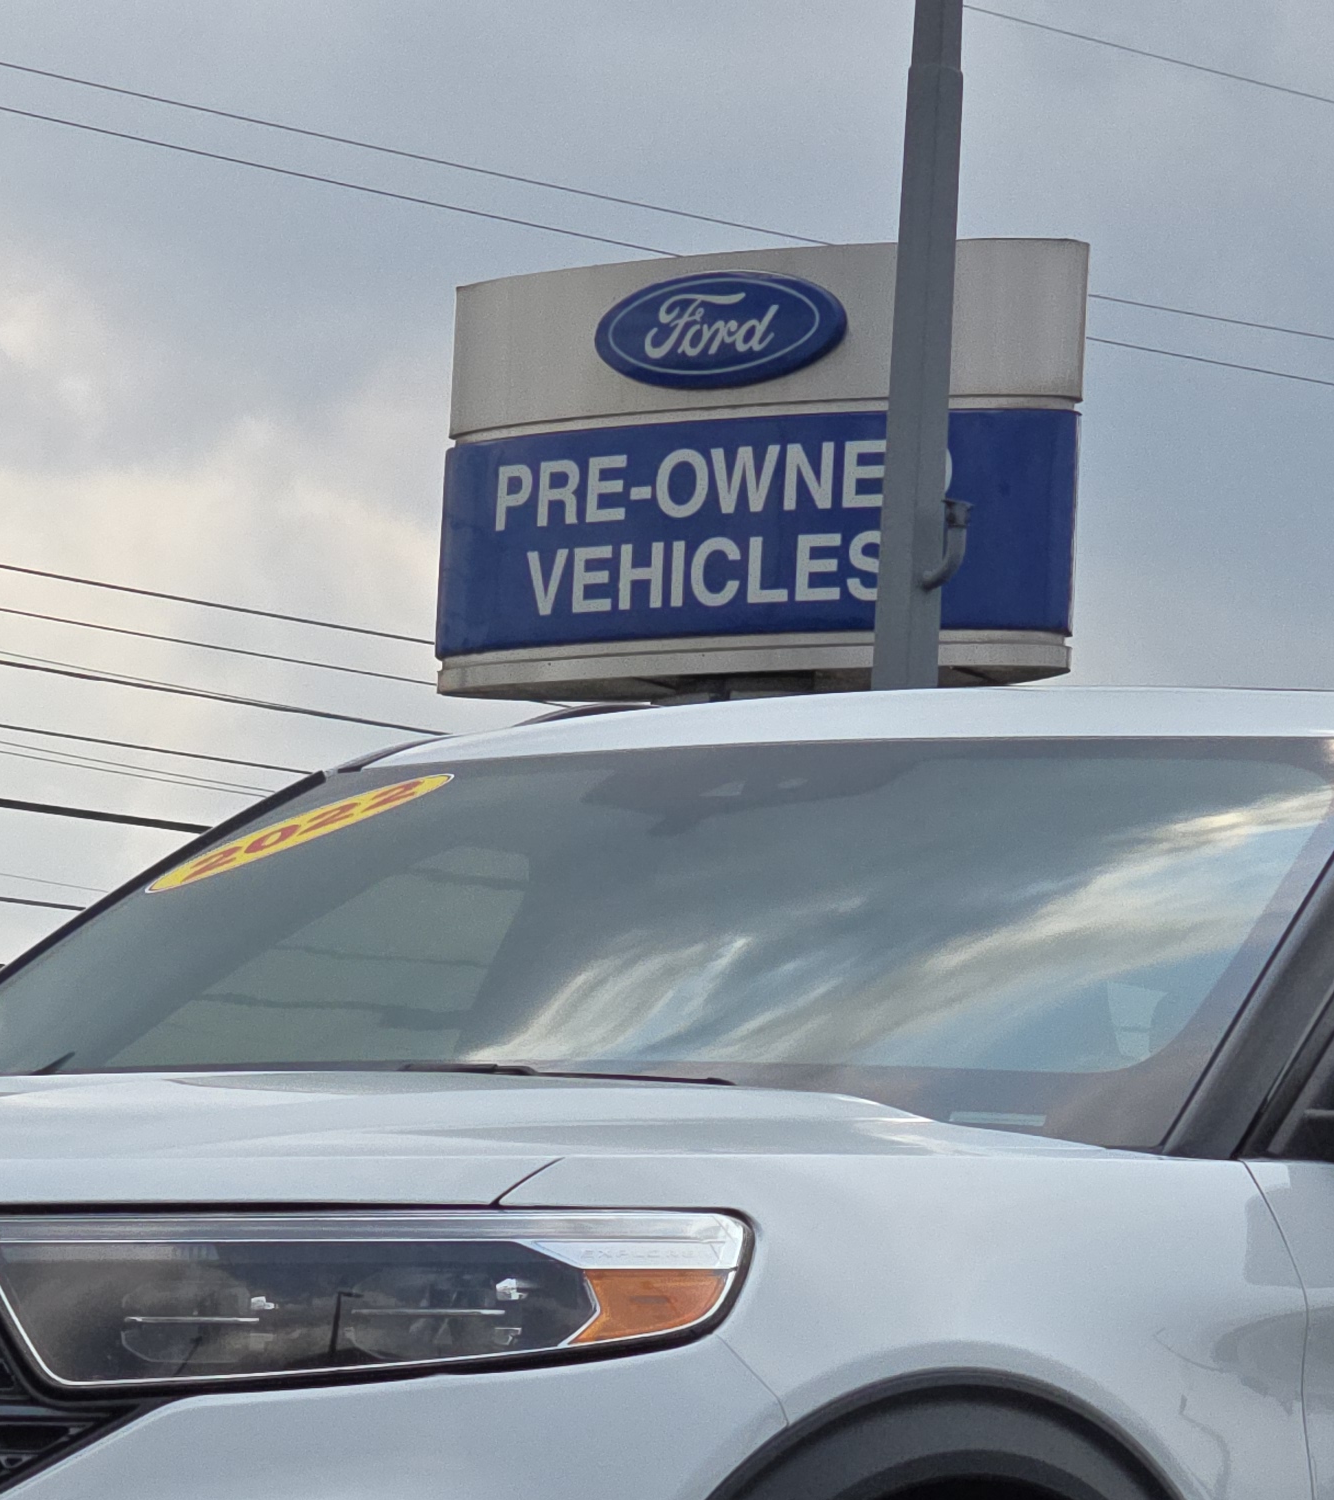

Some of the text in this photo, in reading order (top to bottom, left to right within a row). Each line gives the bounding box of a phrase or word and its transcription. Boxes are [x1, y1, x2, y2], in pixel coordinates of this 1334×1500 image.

[645, 291, 779, 359] Ford
[495, 439, 952, 532] PRE-OWNE
[526, 530, 882, 616] VEHICLES
[179, 778, 425, 883] 2022
